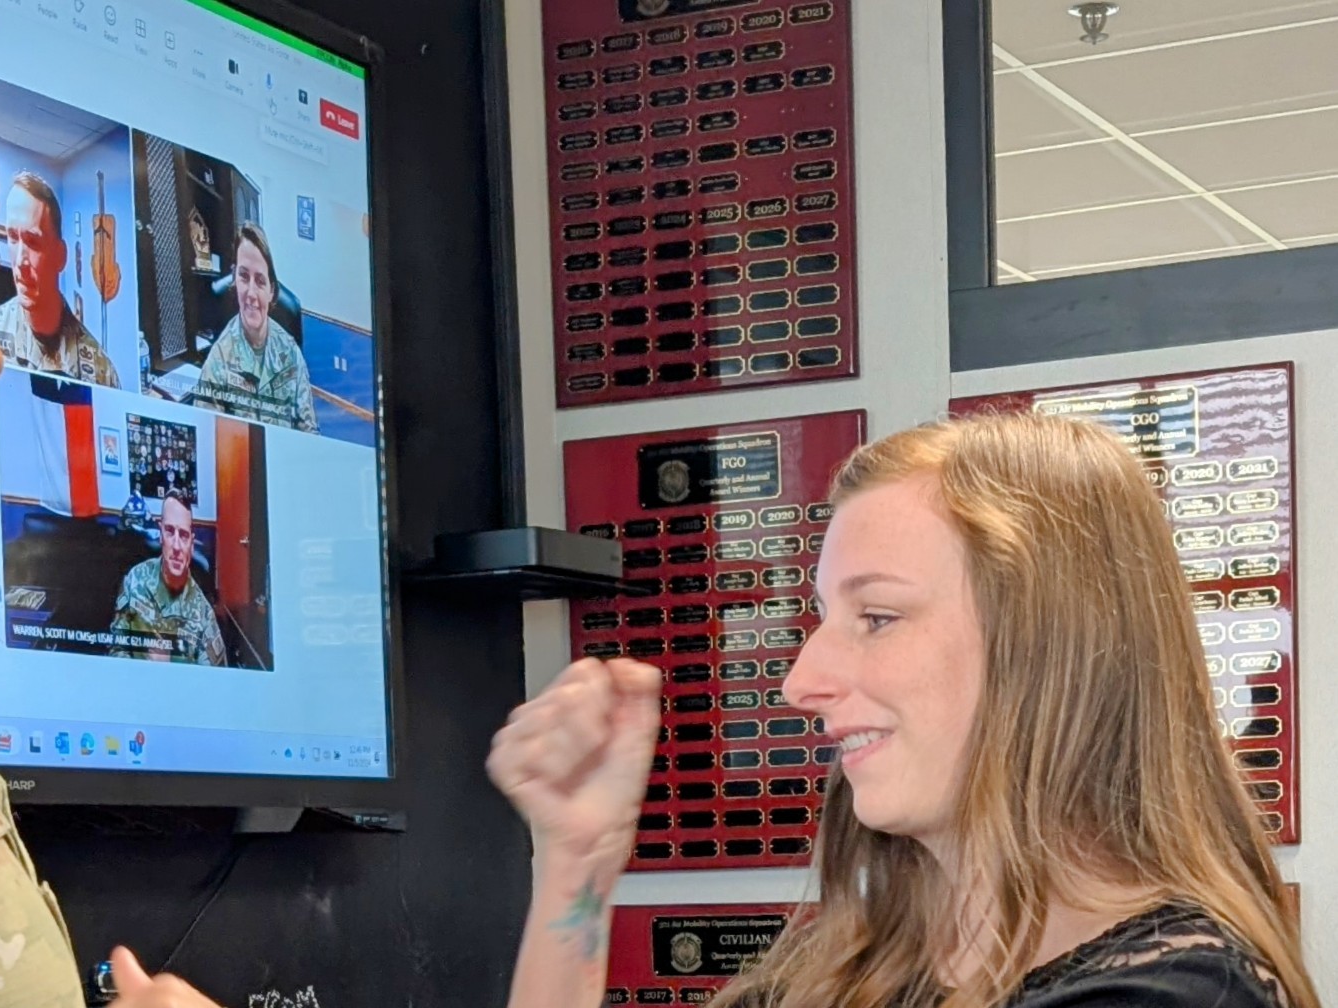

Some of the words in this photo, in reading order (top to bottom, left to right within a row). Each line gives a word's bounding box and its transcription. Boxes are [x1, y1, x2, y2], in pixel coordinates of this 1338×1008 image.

[749, 14, 777, 27] 2020
[798, 6, 825, 19] 2021
[706, 207, 734, 220] 2025
[753, 201, 782, 216] 2026
[802, 194, 830, 207] 2027
[1149, 392, 1189, 406] Squadron
[1130, 411, 1160, 426] CGO
[738, 437, 772, 450] Squadron
[721, 456, 747, 469] FGO
[1182, 467, 1215, 480] 2020
[732, 485, 761, 495] Winners
[721, 514, 748, 526] 2019
[767, 510, 796, 522] 2020
[815, 507, 836, 518] 202
[12, 623, 45, 640] WARREN,
[45, 627, 67, 641] SCOTT
[97, 632, 114, 645] USAF
[114, 633, 130, 646] AMC
[130, 634, 142, 647] 621
[726, 694, 754, 705] 2025
[6, 780, 36, 790] HARP
[683, 919, 711, 929] Mobility
[719, 933, 772, 946] CIVILIAN
[606, 991, 623, 1001] 016
[687, 990, 712, 1001] 2018
